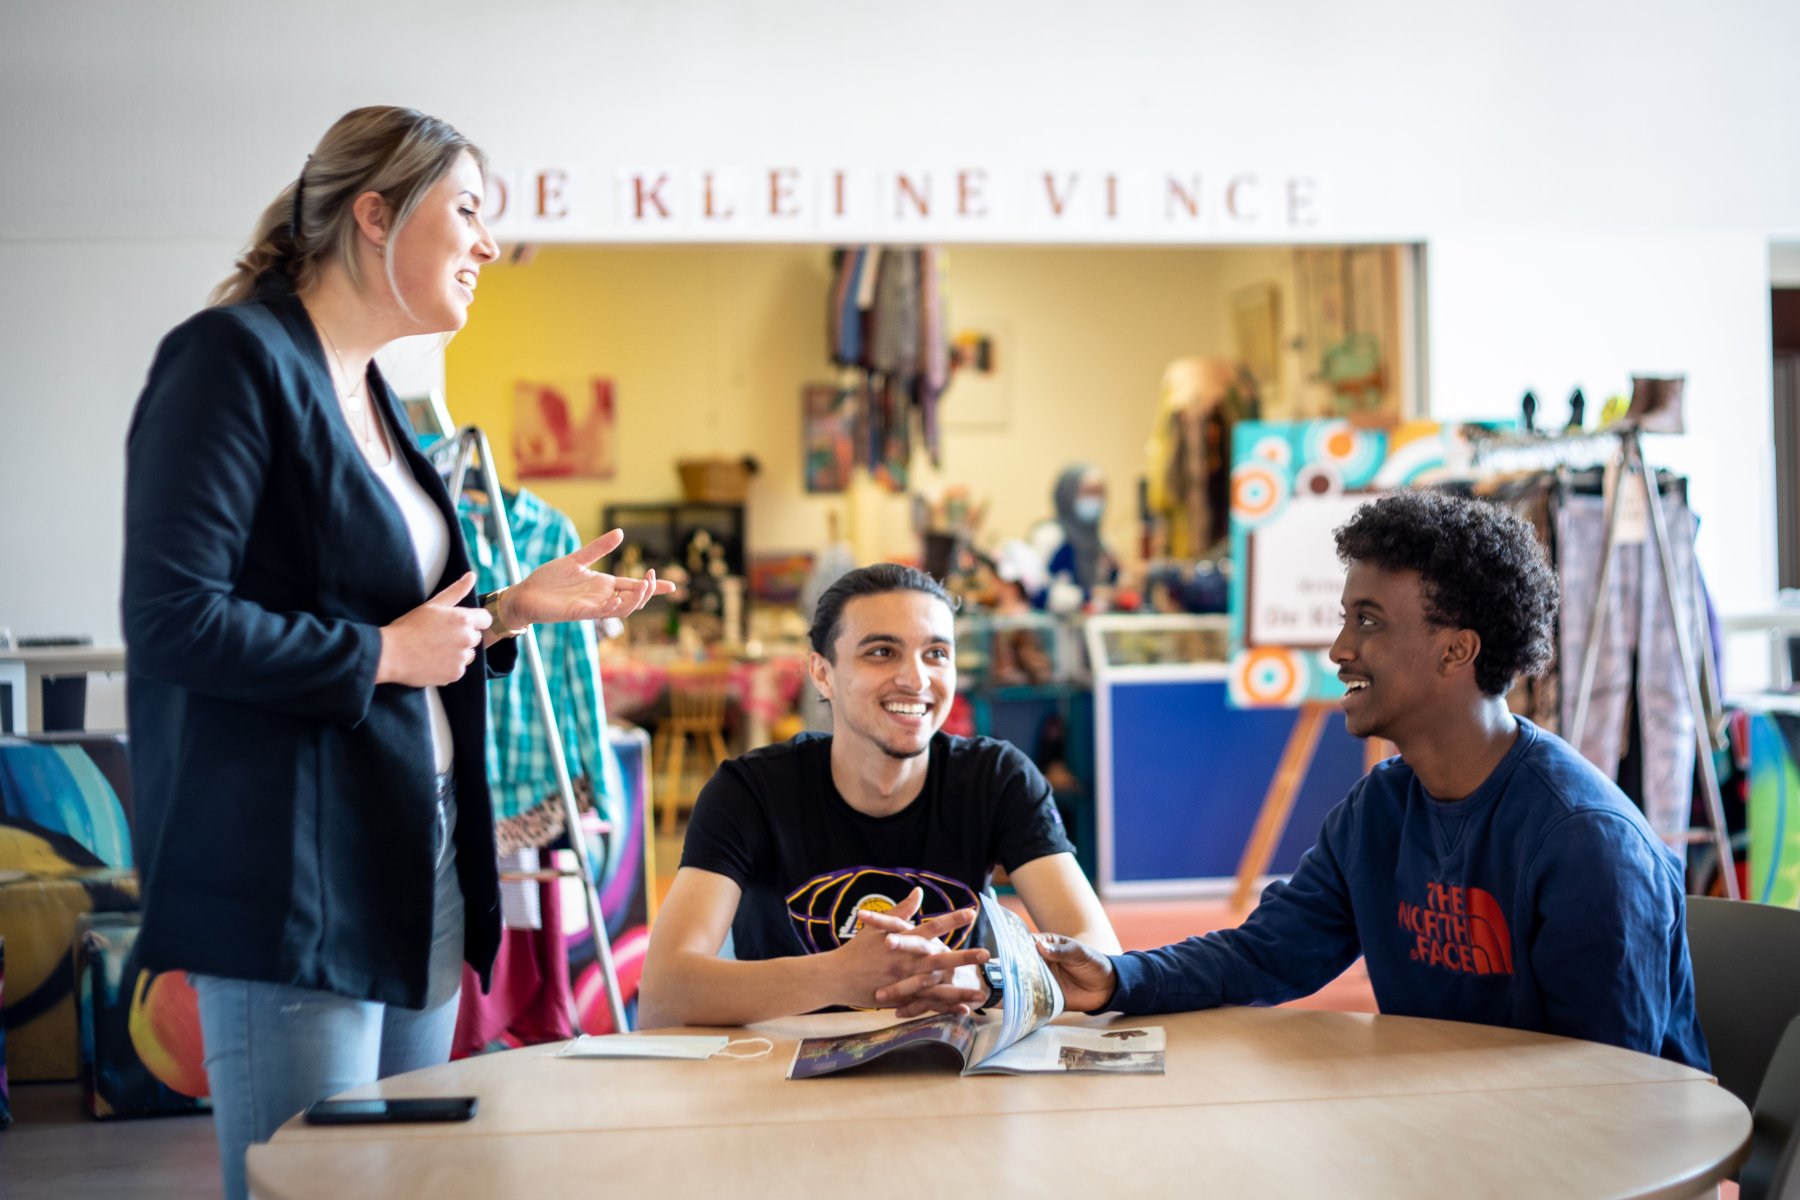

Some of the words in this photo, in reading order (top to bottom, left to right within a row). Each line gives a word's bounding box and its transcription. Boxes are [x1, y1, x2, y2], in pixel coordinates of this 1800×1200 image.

[631, 167, 989, 219] KLEINE
[1041, 170, 1318, 226] VINCE
[1427, 882, 1464, 915] THE
[1398, 900, 1471, 944] NORTH
[1417, 935, 1475, 973] FACE
